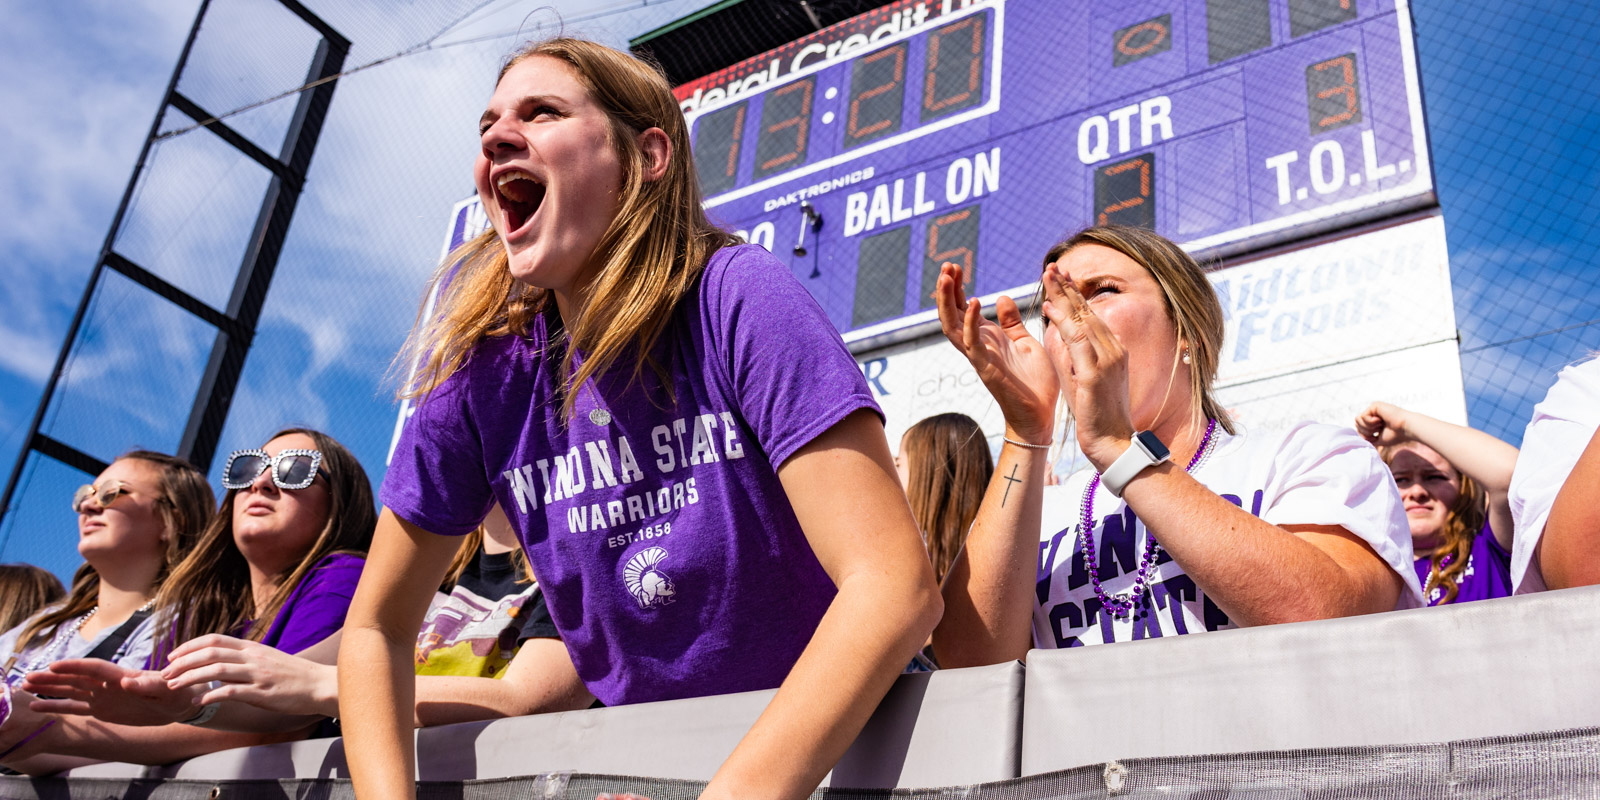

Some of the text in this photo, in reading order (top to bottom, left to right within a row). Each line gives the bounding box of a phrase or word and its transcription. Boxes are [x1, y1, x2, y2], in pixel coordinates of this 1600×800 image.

[790, 3, 929, 73] Credit
[1314, 57, 1357, 127] 3
[1077, 96, 1174, 164] QTR
[764, 167, 875, 212] DAKTRONICS
[844, 148, 1001, 238] BALL ON
[1265, 129, 1411, 205] T.O.L.
[928, 210, 973, 299] 5
[1232, 287, 1391, 363] Foods
[503, 411, 744, 515] WINONA STATE
[567, 477, 699, 534] WARRIORS
